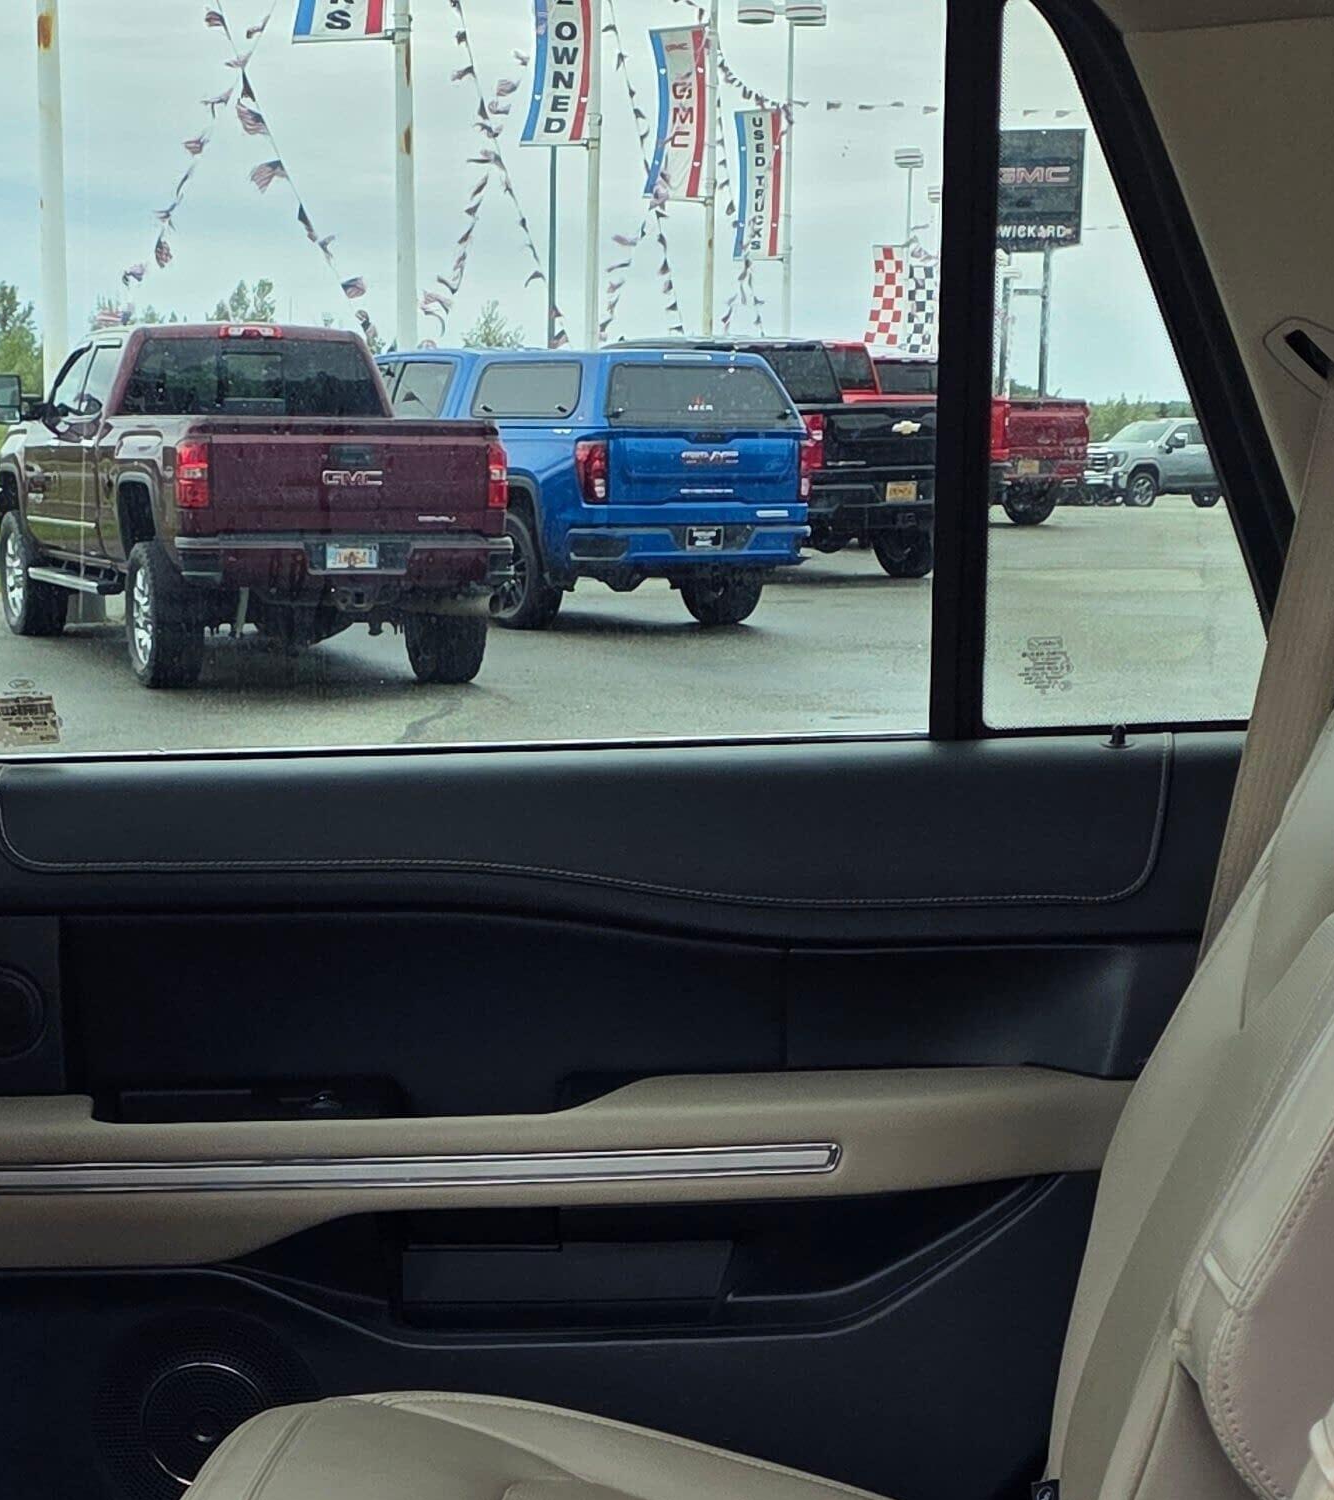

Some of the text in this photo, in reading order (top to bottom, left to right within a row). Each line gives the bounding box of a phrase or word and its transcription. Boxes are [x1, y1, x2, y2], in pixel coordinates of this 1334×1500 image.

[544, 21, 579, 134] OWNED
[671, 81, 693, 148] GMC
[750, 117, 766, 250] USED TRUCKS
[998, 224, 1068, 239] WICKARD
[322, 469, 383, 486] GMC
